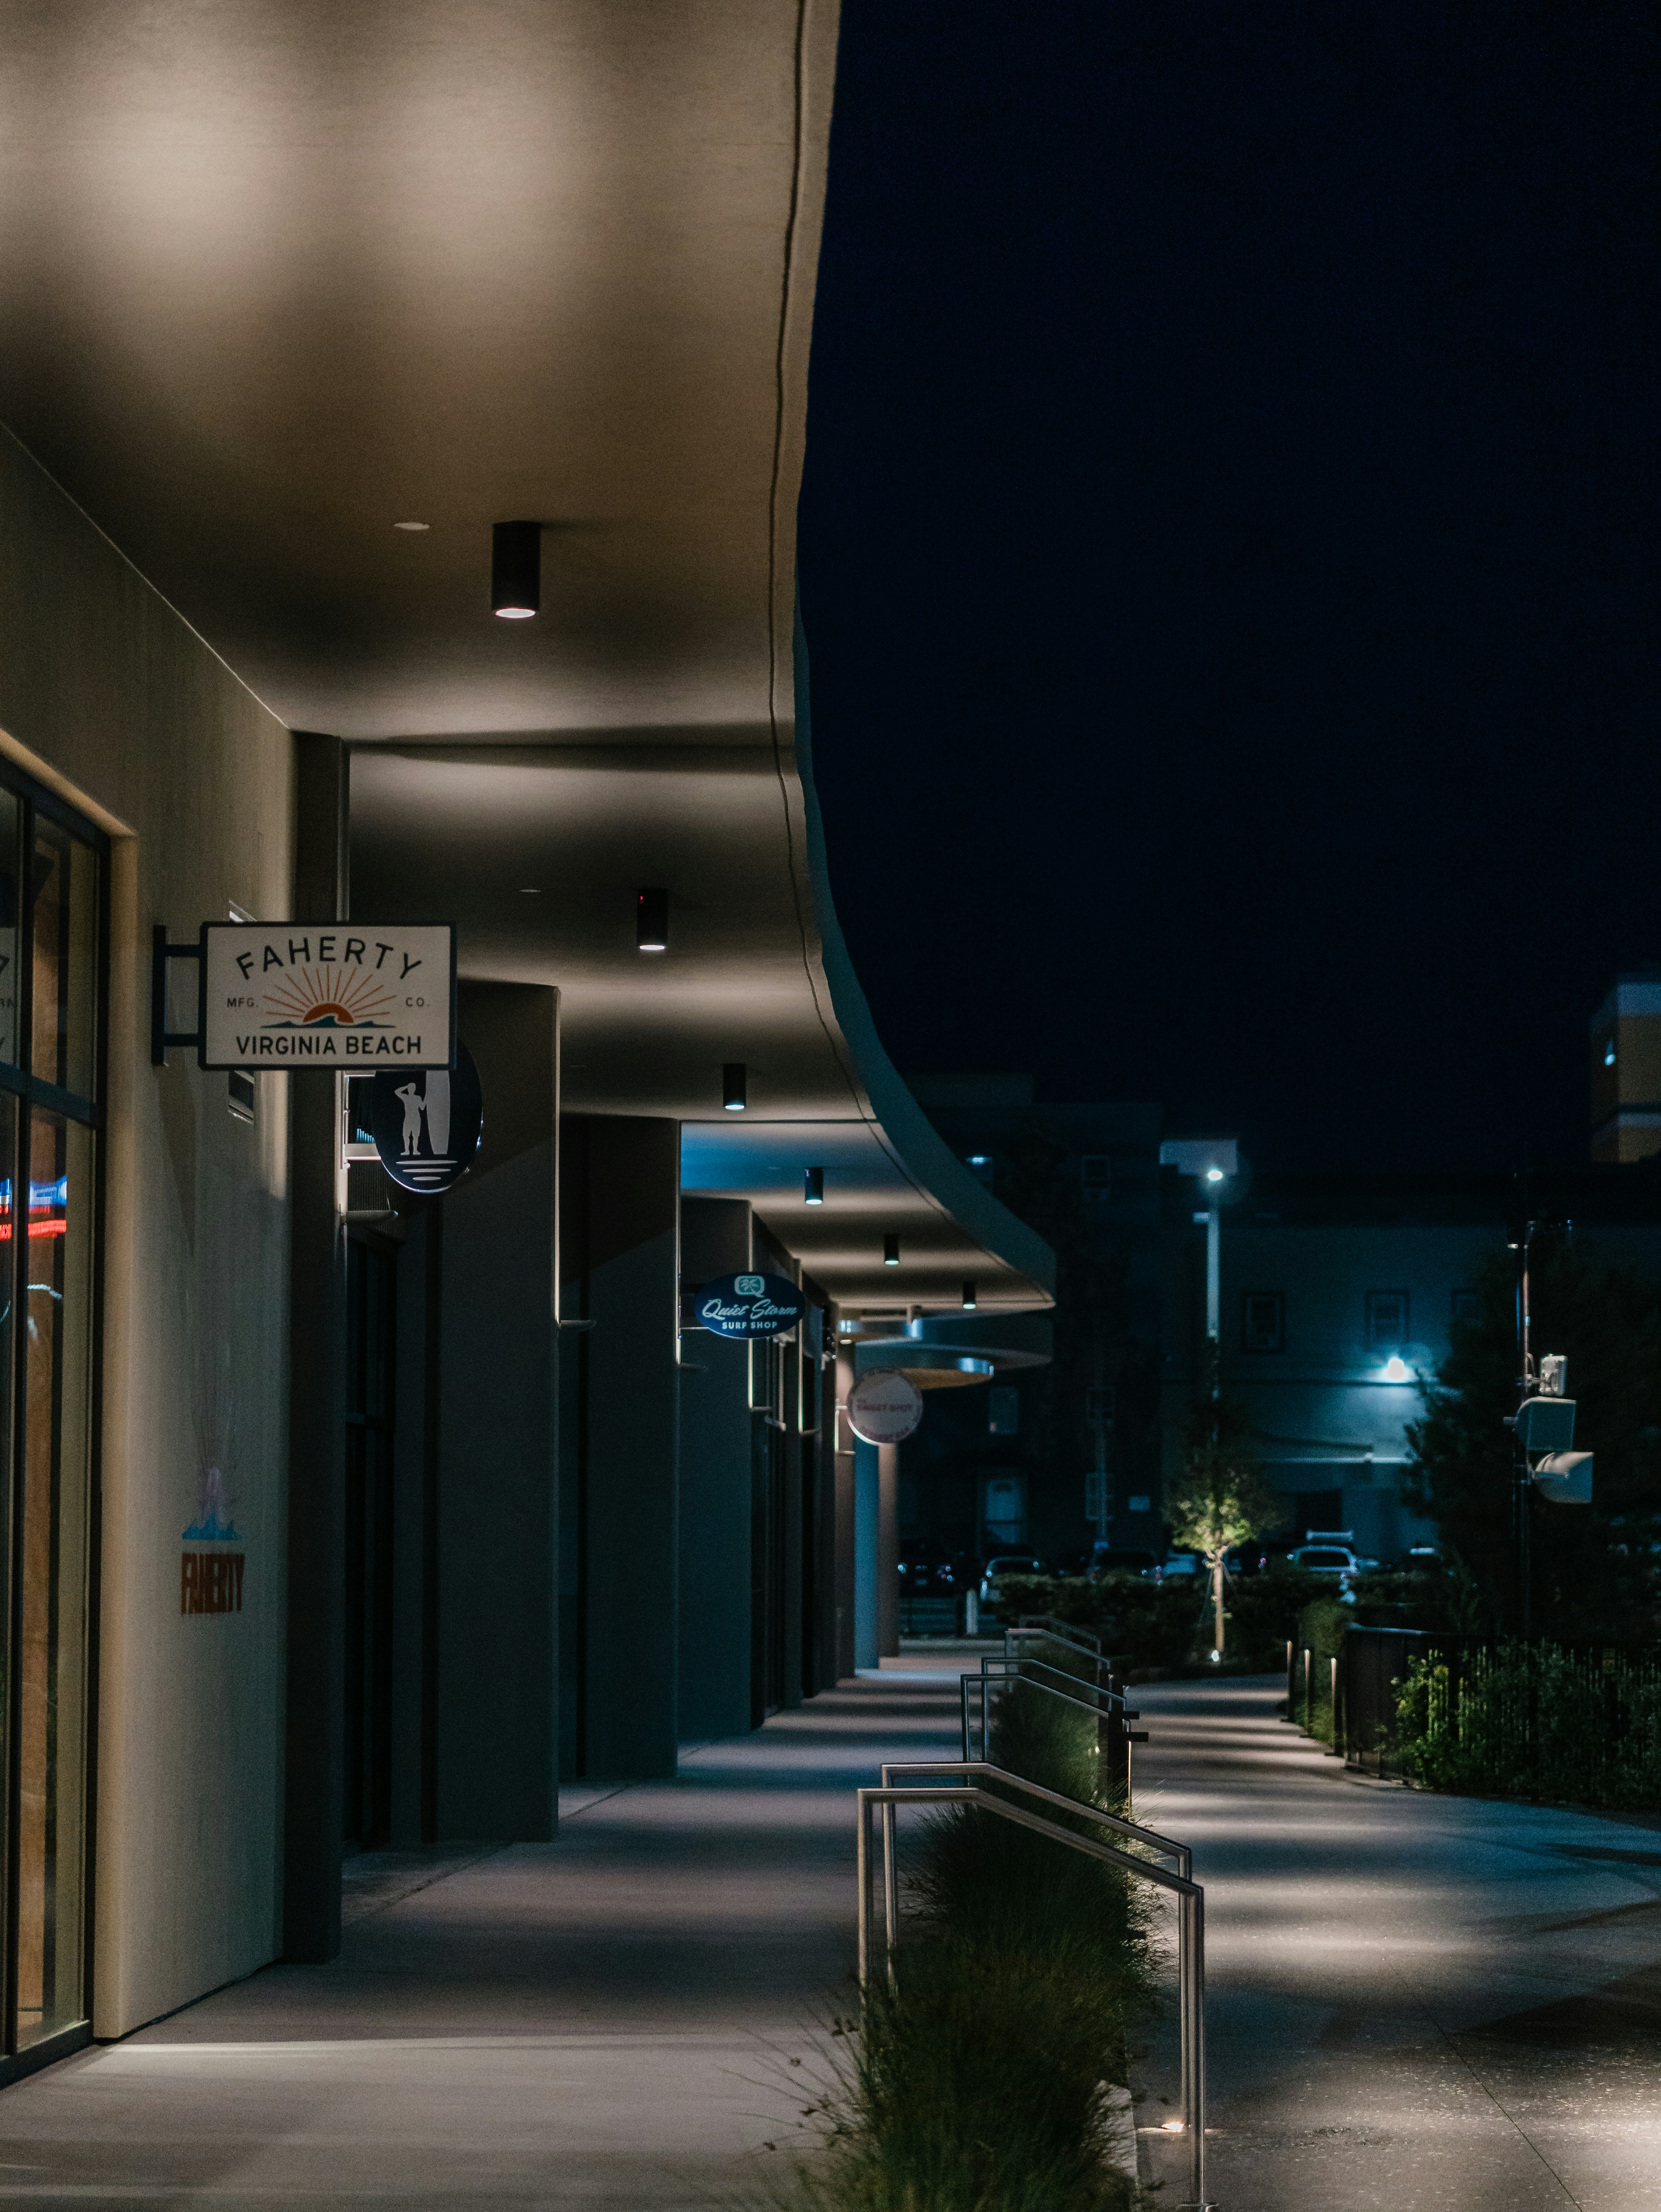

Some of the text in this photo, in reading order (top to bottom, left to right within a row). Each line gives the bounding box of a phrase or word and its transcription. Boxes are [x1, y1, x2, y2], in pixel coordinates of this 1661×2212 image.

[235, 935, 422, 980] FAHERTY
[226, 996, 431, 1008] MFG. CO.
[235, 1035, 421, 1055] VIRGINIA BEACH
[702, 1298, 797, 1320] Quiet Storm
[722, 1321, 778, 1330] SURF SHOP
